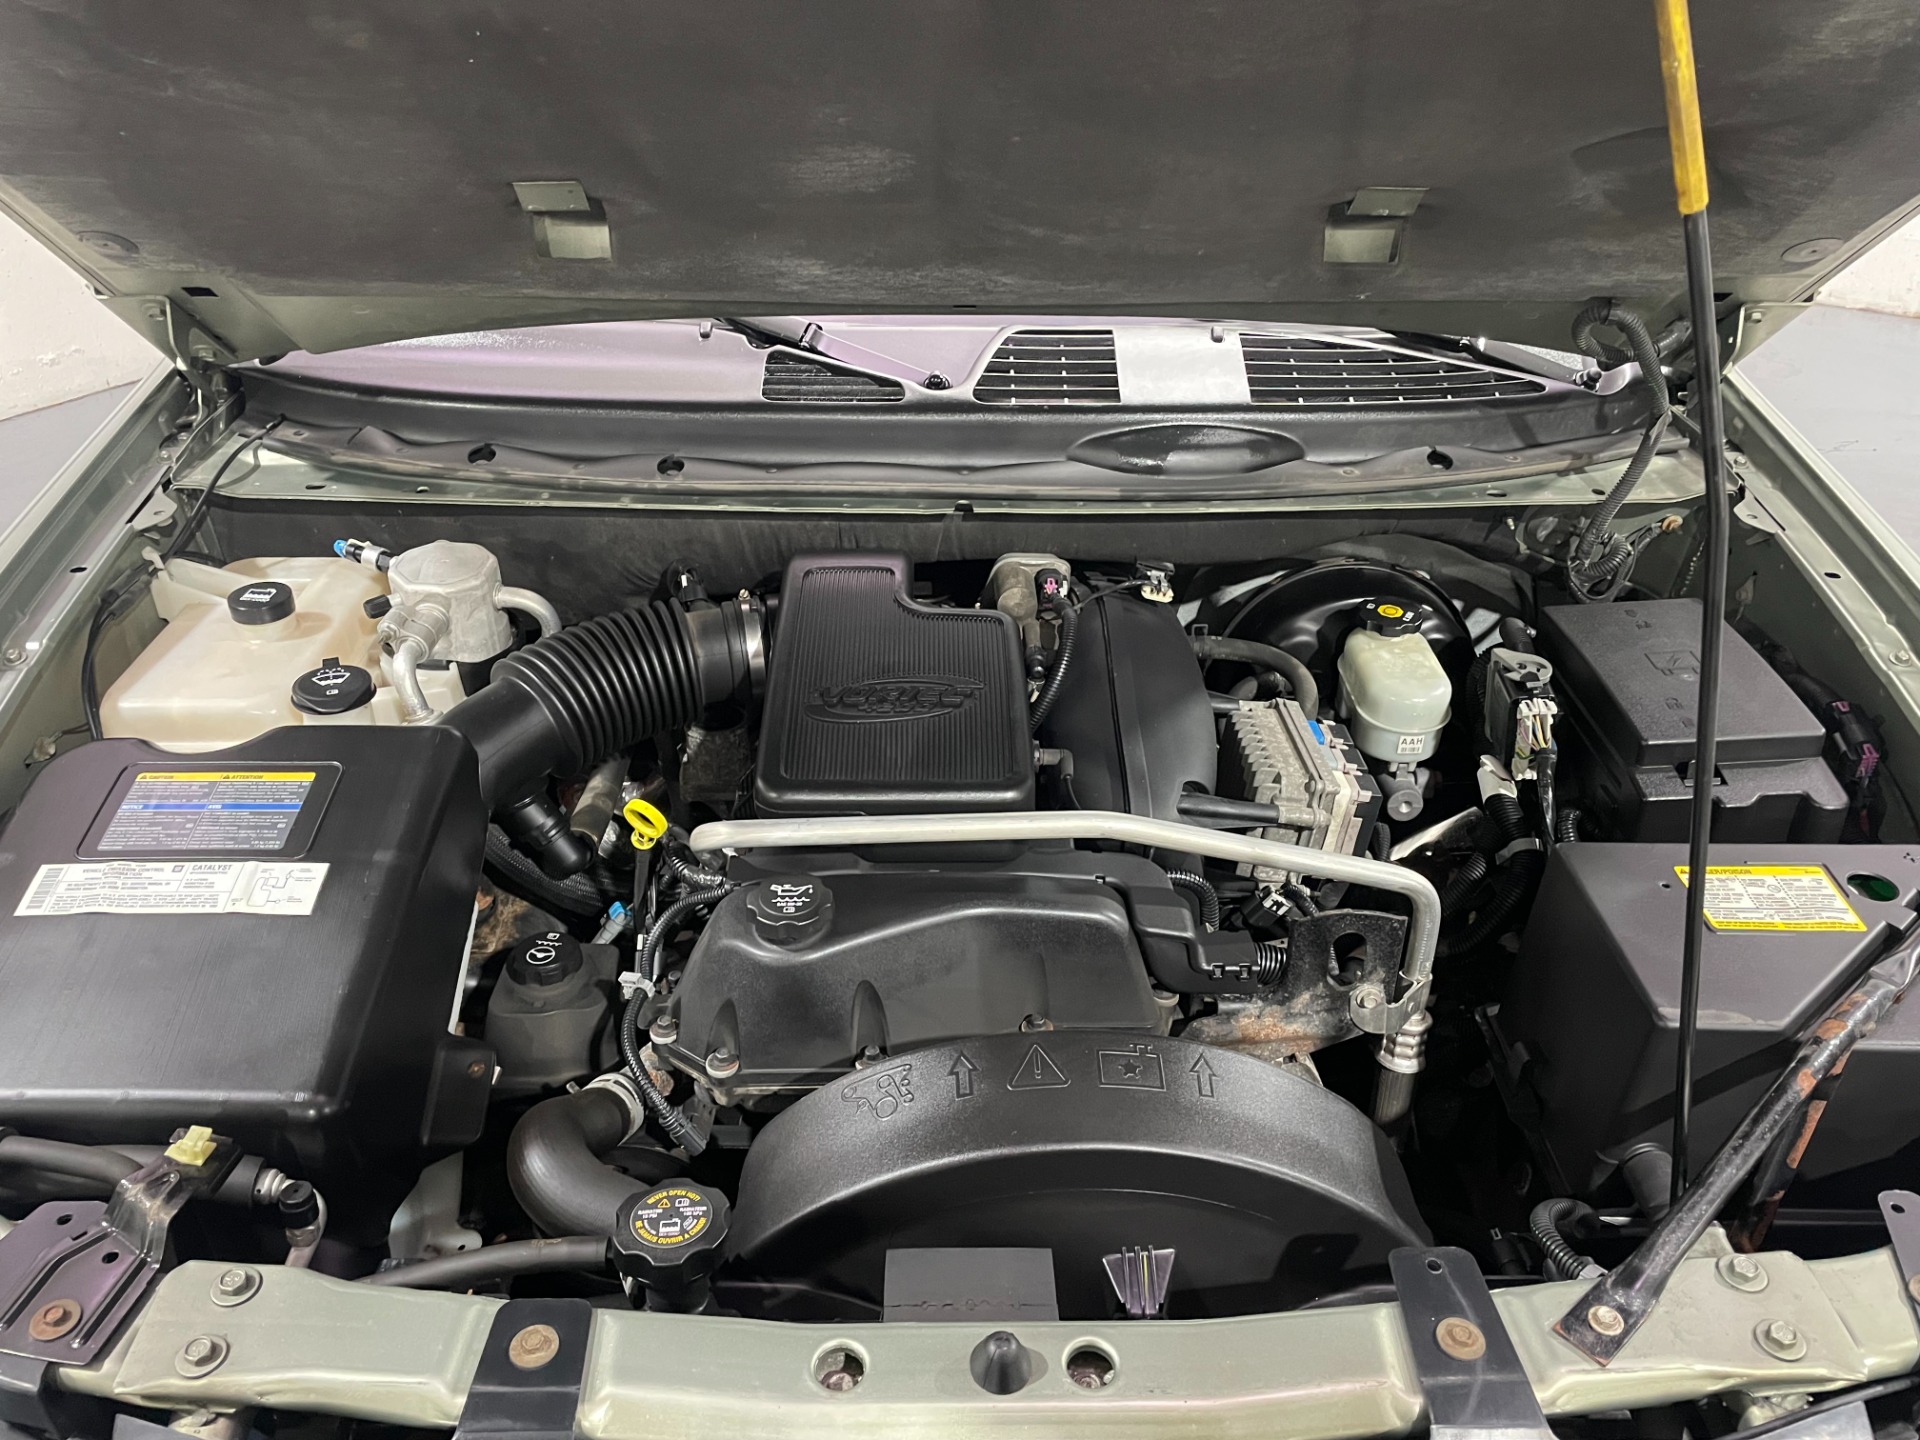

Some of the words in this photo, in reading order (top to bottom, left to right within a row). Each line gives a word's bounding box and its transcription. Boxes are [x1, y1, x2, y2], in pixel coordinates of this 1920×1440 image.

[820, 685, 975, 708] VORTEC
[1400, 737, 1424, 746] AAH
[646, 1191, 668, 1204] NEVER
[686, 1190, 701, 1202] HOT!
[635, 1220, 643, 1228] NE
[689, 1217, 707, 1235] CHAUD!
[638, 1227, 658, 1243] JAMAIS
[658, 1236, 684, 1244] OUVRIR
